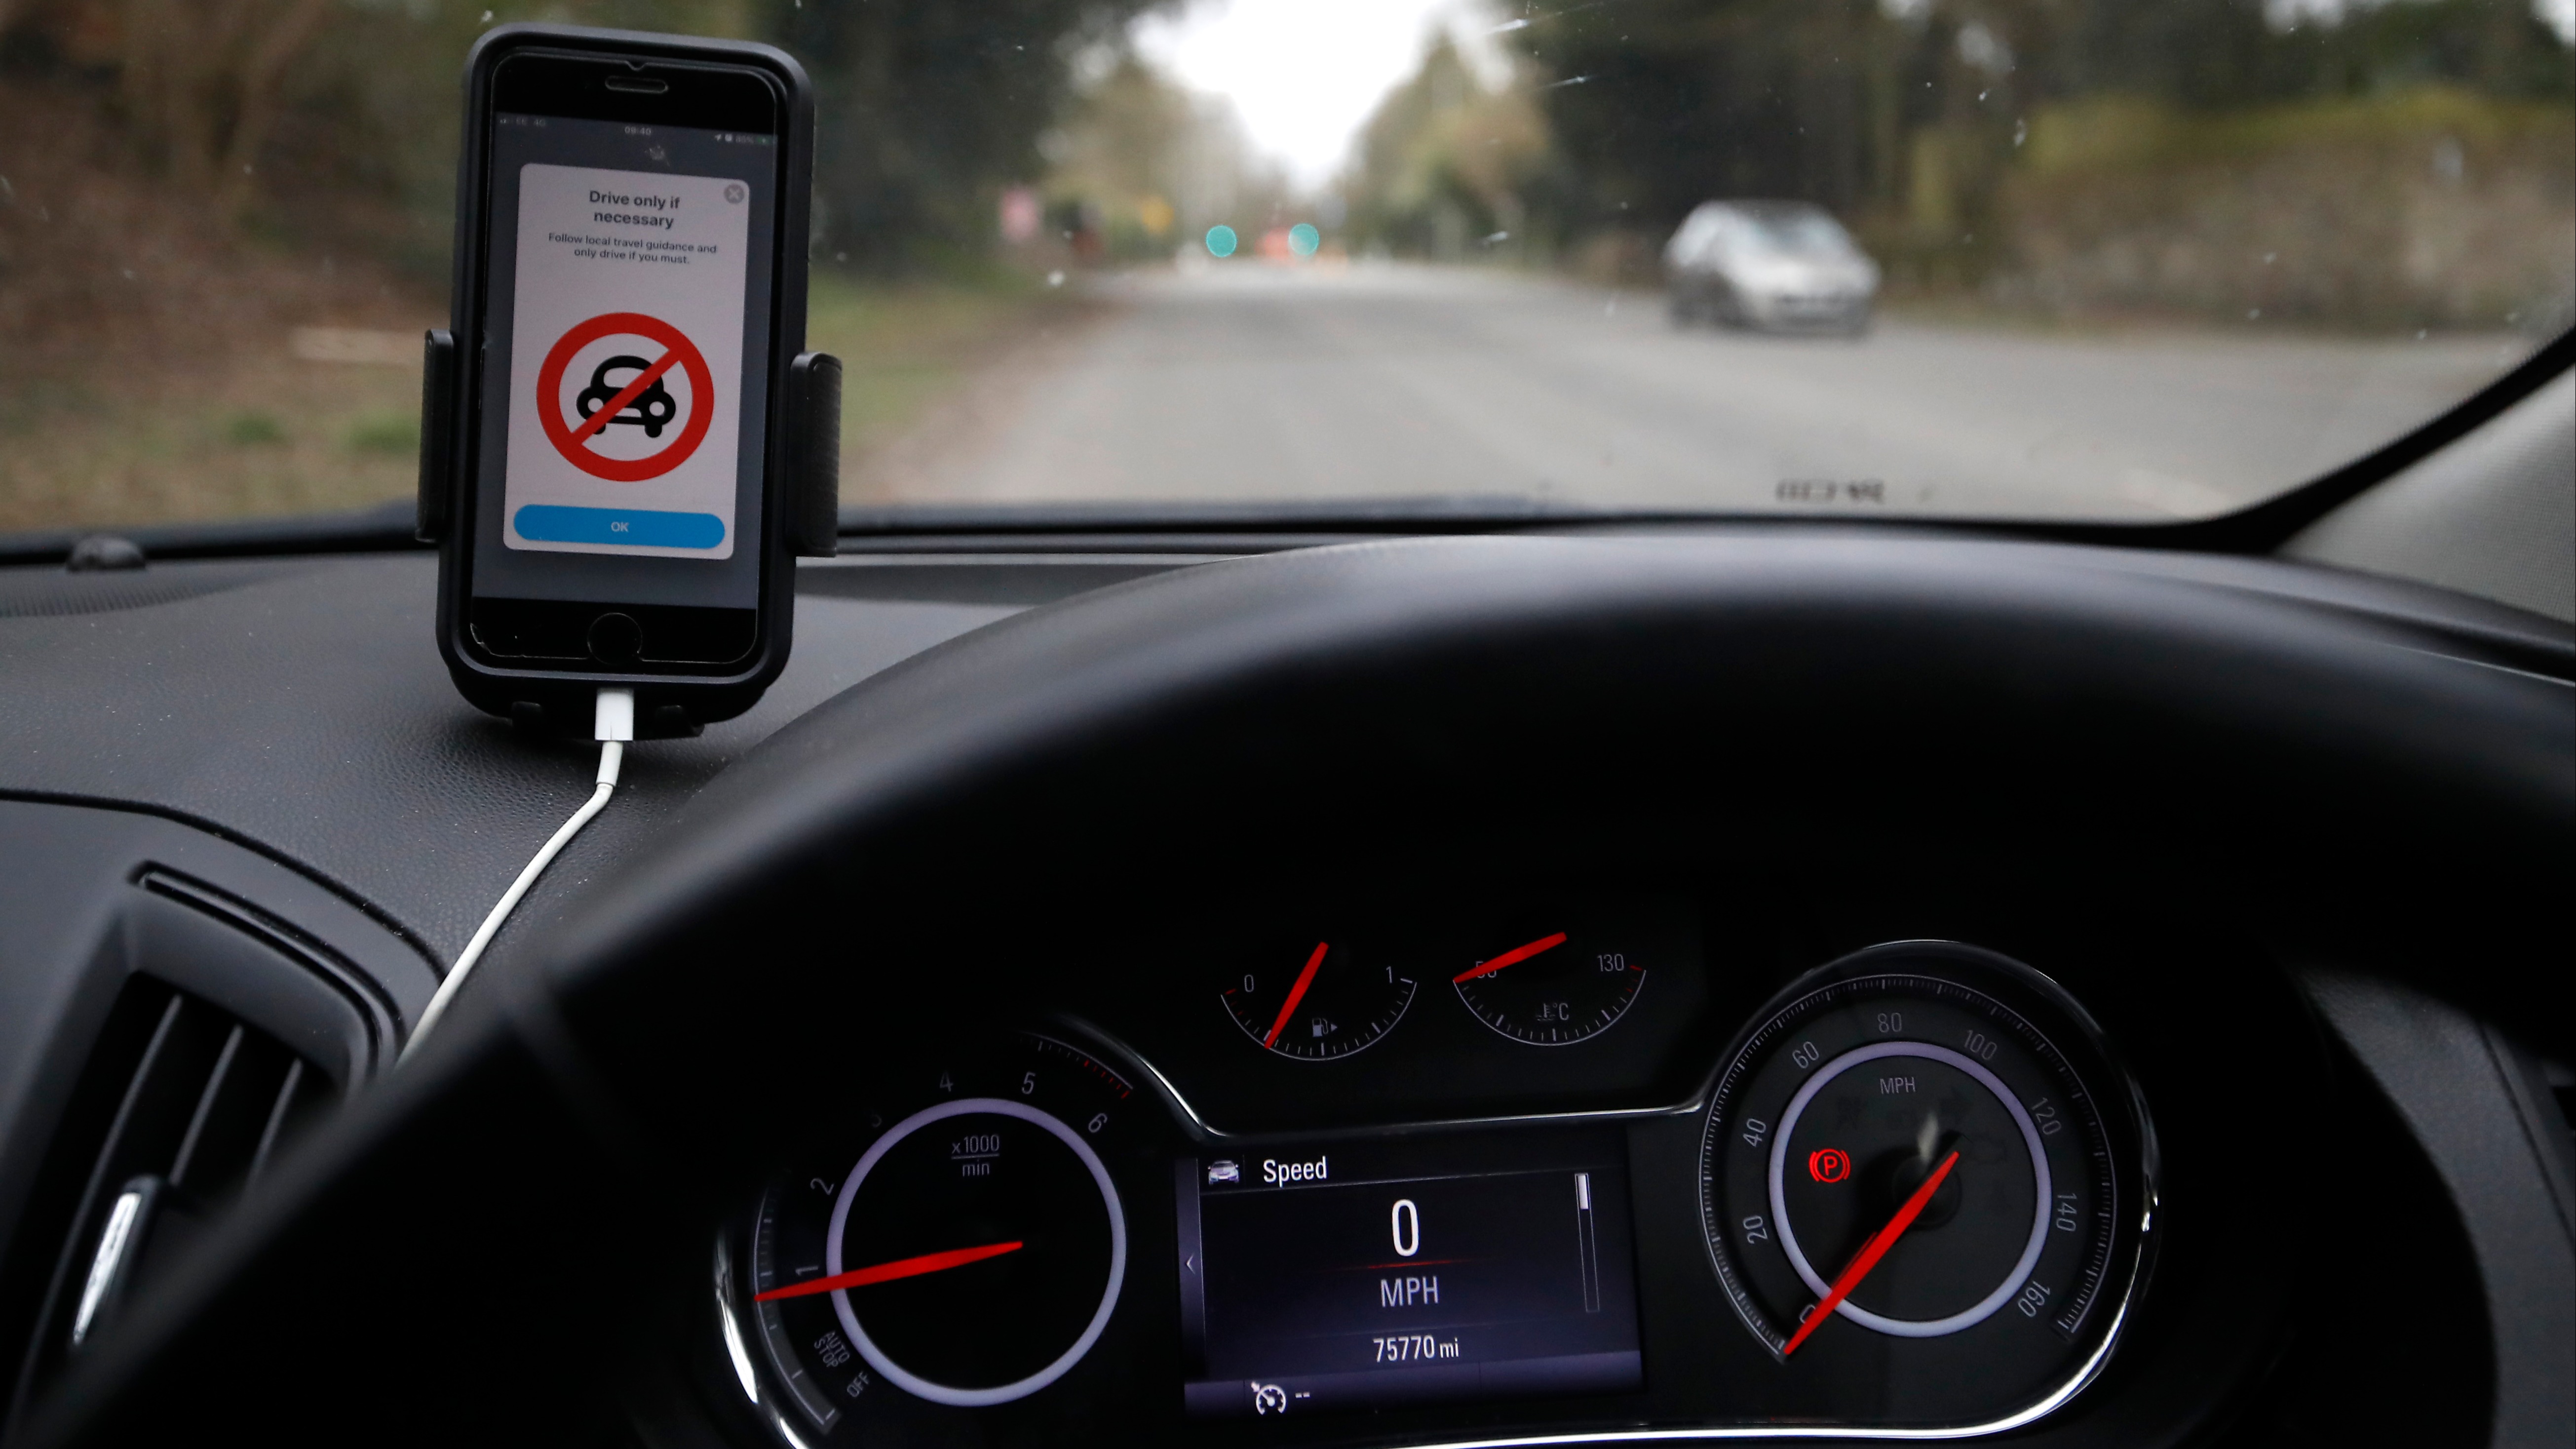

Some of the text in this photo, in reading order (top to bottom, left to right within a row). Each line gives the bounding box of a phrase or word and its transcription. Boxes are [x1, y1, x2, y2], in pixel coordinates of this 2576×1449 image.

[589, 190, 680, 210] Drive only if
[594, 212, 674, 230] necessary
[549, 233, 717, 253] Follow local travel guidance and
[574, 248, 690, 264] only drive if you must.
[611, 521, 629, 532] OK
[1597, 953, 1624, 973] 130
[1244, 974, 1254, 992] 0
[1385, 966, 1393, 983] 1
[1877, 1012, 1902, 1033] 80
[1792, 1041, 1819, 1070] 60
[1963, 1029, 1998, 1061] 100
[939, 1071, 953, 1092] 4
[1022, 1072, 1036, 1095] 5
[1880, 1077, 1916, 1095] MPH
[1088, 1113, 1108, 1134] 6
[2031, 1097, 2061, 1136] 120
[1742, 1118, 1767, 1148] 40
[952, 1135, 1000, 1154] x1000
[962, 1159, 990, 1177] min
[1263, 1156, 1327, 1187] Speed
[810, 1177, 834, 1195] 2
[2056, 1193, 2077, 1232] 140
[1392, 1199, 1419, 1257] 0
[1743, 1215, 1769, 1245] 20
[796, 1265, 818, 1277] 1
[1381, 1275, 1439, 1308] MPH
[2017, 1280, 2051, 1317] 160
[813, 1339, 838, 1368] STOP
[824, 1330, 850, 1364] AUTO
[1373, 1334, 1459, 1363] 75770 mi
[846, 1370, 870, 1398] OFF
